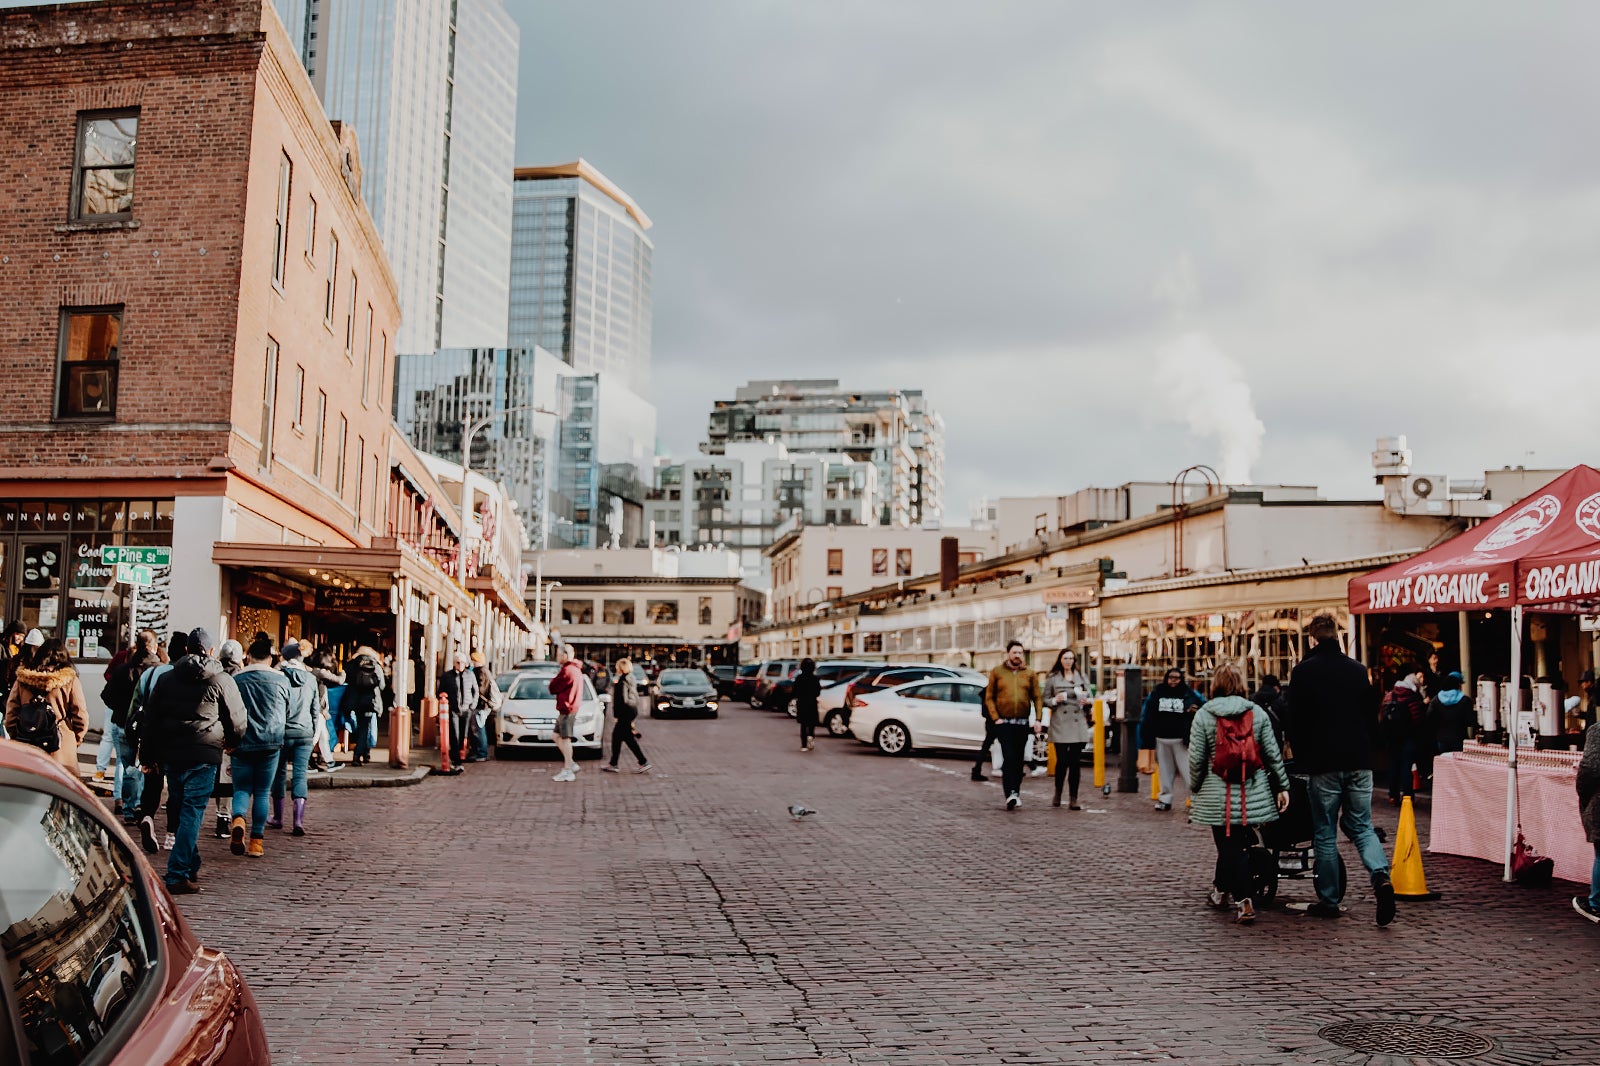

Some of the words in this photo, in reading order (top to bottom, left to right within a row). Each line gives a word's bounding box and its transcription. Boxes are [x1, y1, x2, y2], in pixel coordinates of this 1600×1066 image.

[118, 548, 143, 563] Pine
[77, 562, 113, 577] Power
[1525, 560, 1600, 600] ORGANI
[1367, 575, 1413, 610] TINY'S
[1413, 571, 1490, 606] ORGANIC
[74, 599, 113, 608] BAKERY
[77, 613, 108, 623] SINCE
[80, 628, 104, 637] 1985
